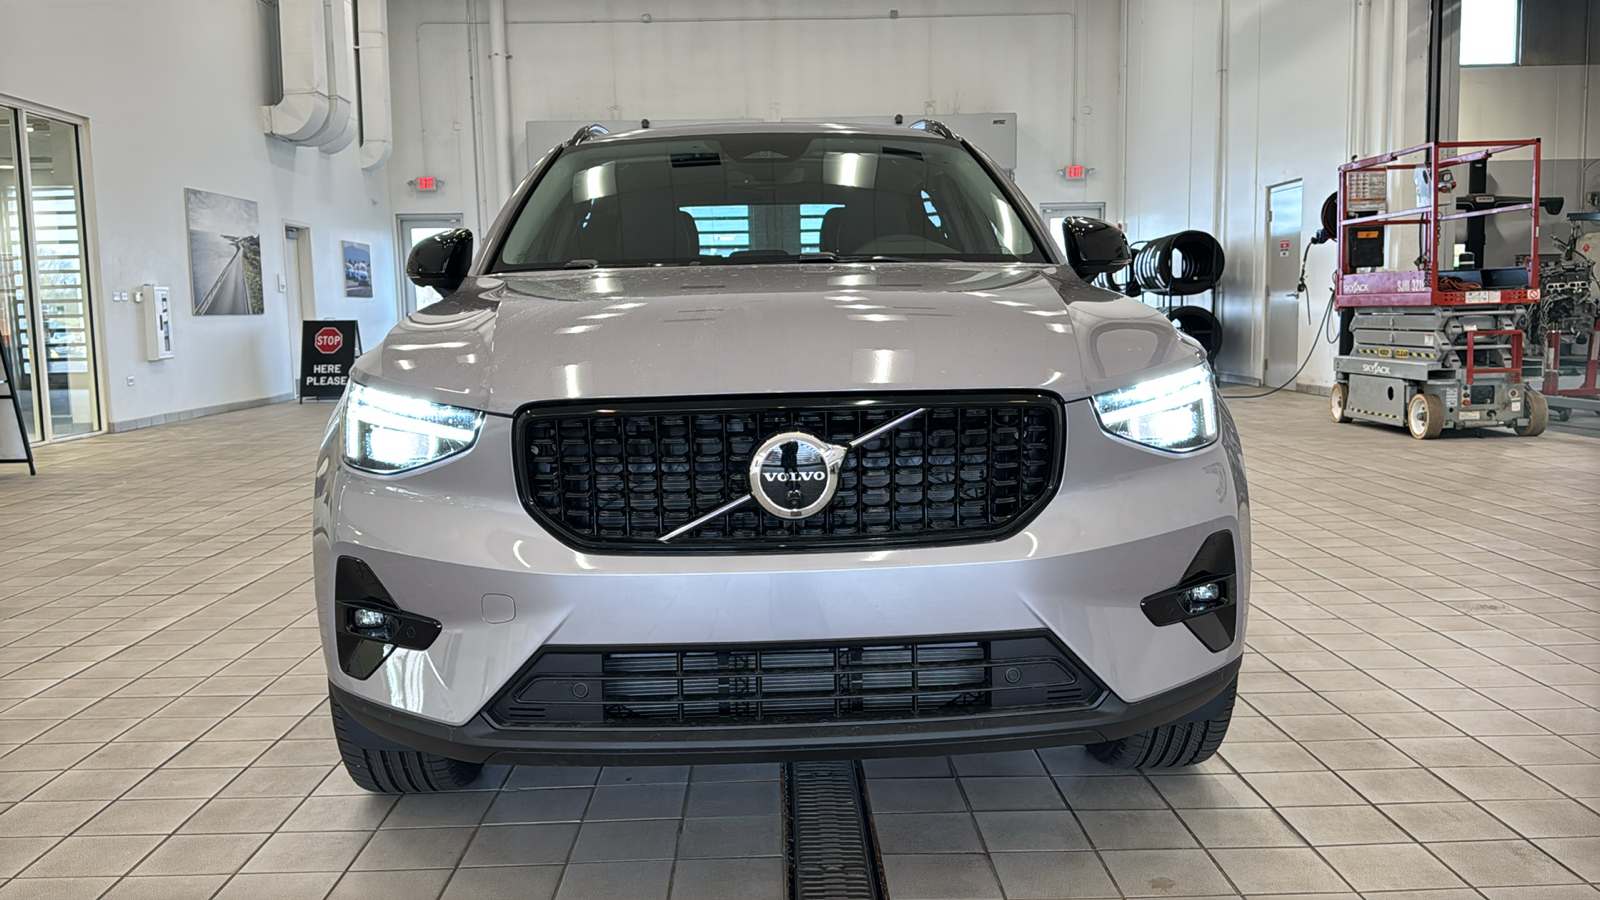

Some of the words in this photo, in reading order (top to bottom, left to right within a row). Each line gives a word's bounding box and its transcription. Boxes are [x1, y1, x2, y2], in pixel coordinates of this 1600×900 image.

[1067, 165, 1083, 178] EXIT
[317, 335, 341, 346] STOP
[313, 364, 342, 374] HERE
[1362, 362, 1391, 375] SKYJACK
[306, 376, 348, 386] PLEASE
[762, 471, 826, 482] VOLVO
